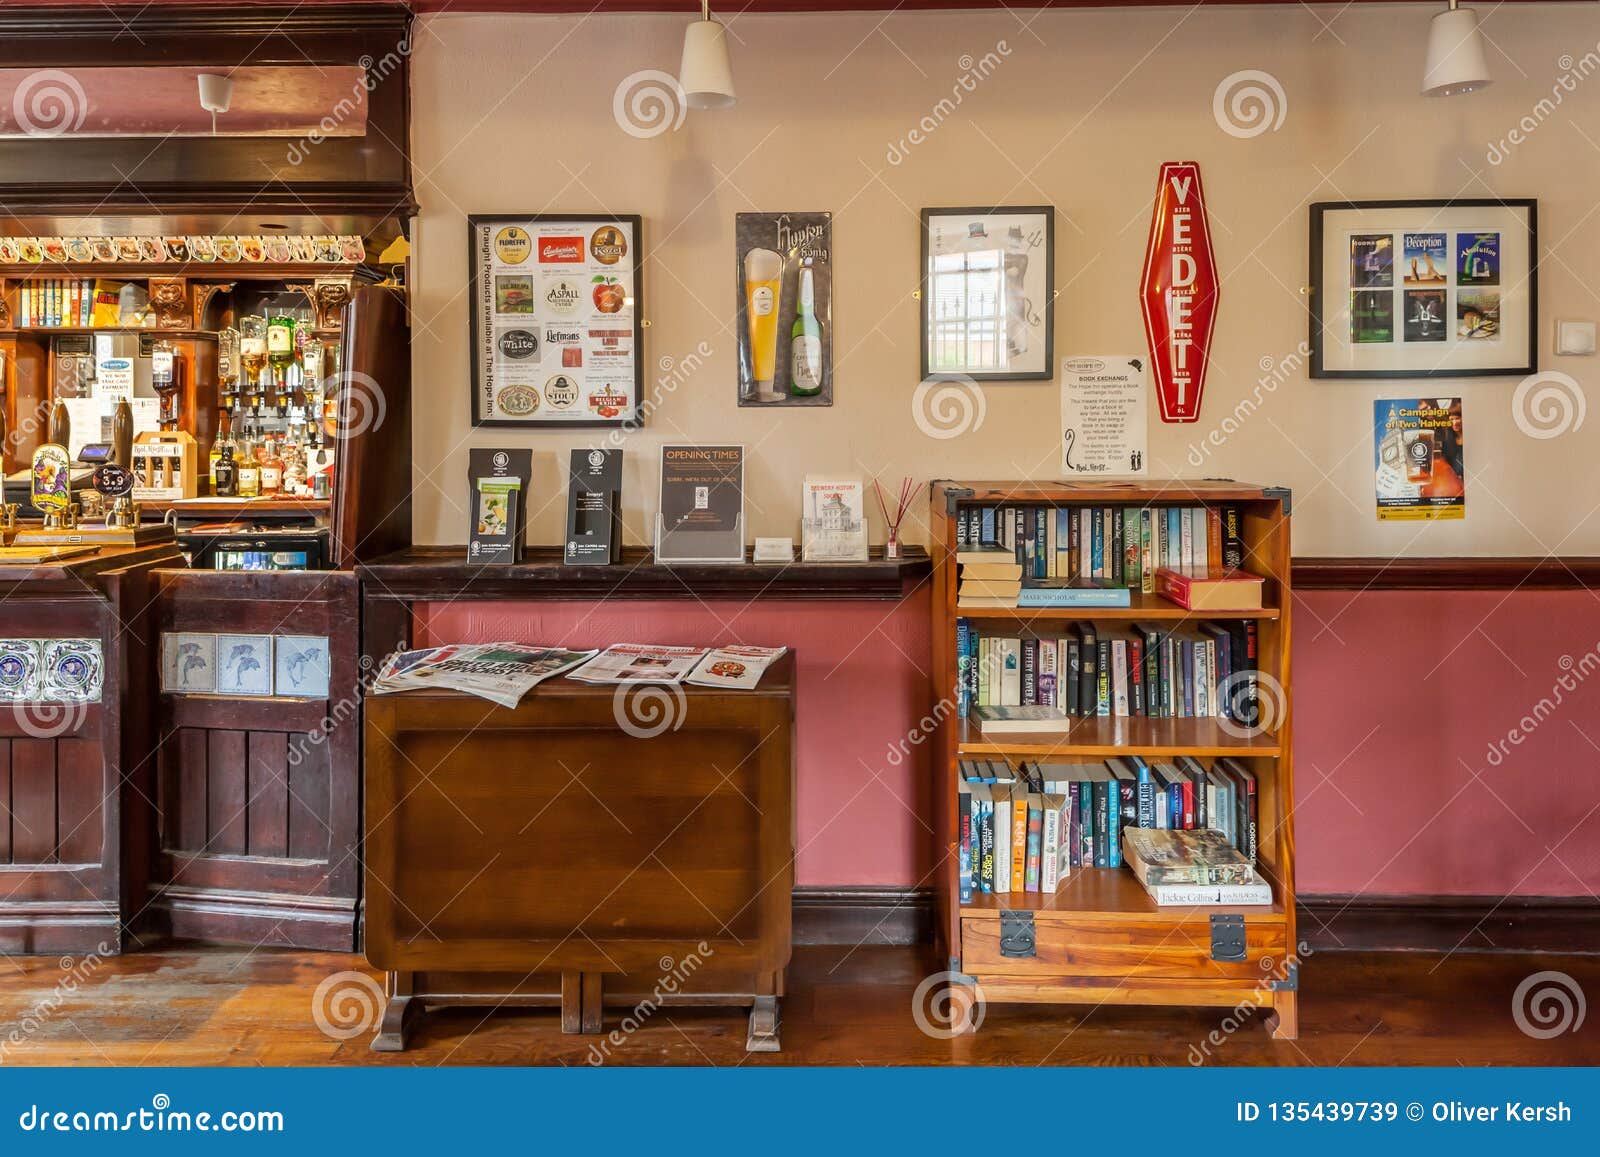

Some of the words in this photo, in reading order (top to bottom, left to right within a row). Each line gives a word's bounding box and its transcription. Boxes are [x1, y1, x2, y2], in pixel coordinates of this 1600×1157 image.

[481, 226, 490, 260] Draught
[1171, 176, 1196, 405] VEDETT
[485, 376, 494, 398] Hope
[1385, 420, 1397, 428] of
[1399, 420, 1417, 428] Two
[1420, 419, 1452, 428] Halves
[1388, 409, 1395, 417] A
[1399, 408, 1449, 419] Campaign
[666, 450, 711, 459] OPENING
[712, 450, 739, 459] TIMES
[1024, 673, 1033, 697] DEAVER
[1249, 822, 1257, 865] GORGEOU
[985, 854, 993, 879] CROSS
